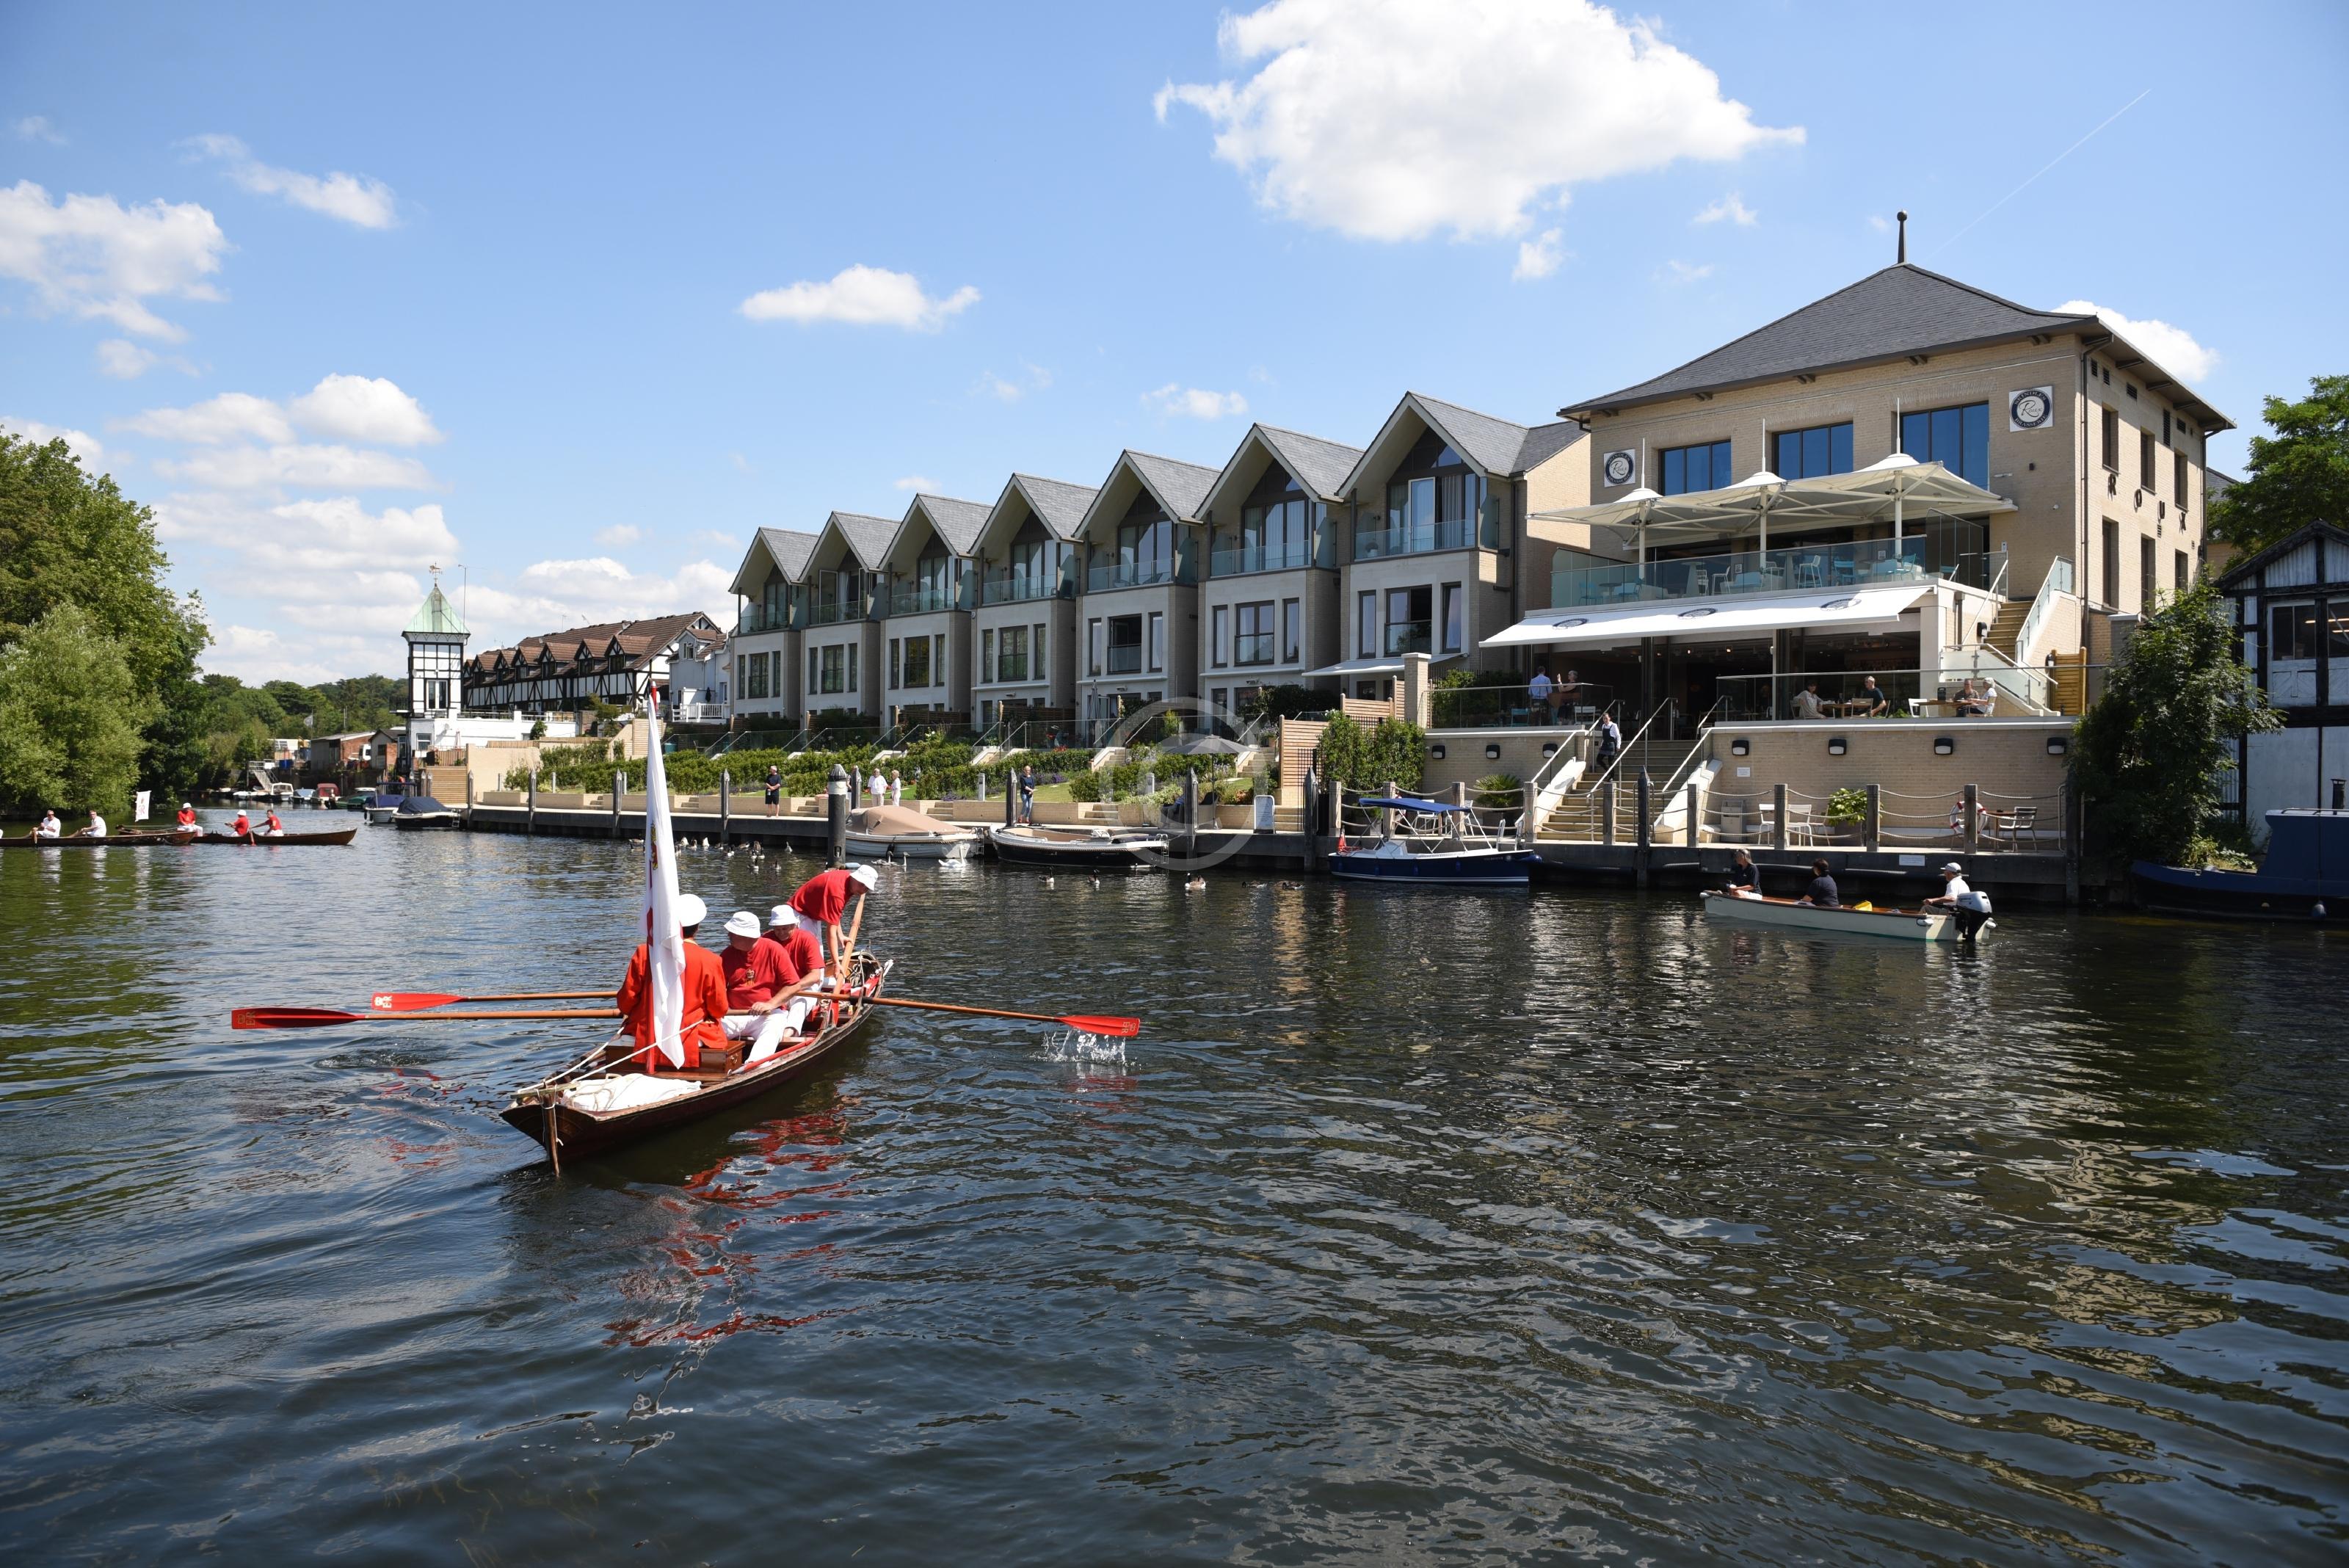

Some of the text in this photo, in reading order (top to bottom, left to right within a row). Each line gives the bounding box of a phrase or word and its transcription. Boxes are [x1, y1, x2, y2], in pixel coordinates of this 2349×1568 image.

[2018, 399, 2044, 418] Roux
[2108, 473, 2187, 531] ROUX
[382, 995, 393, 1009] ER
